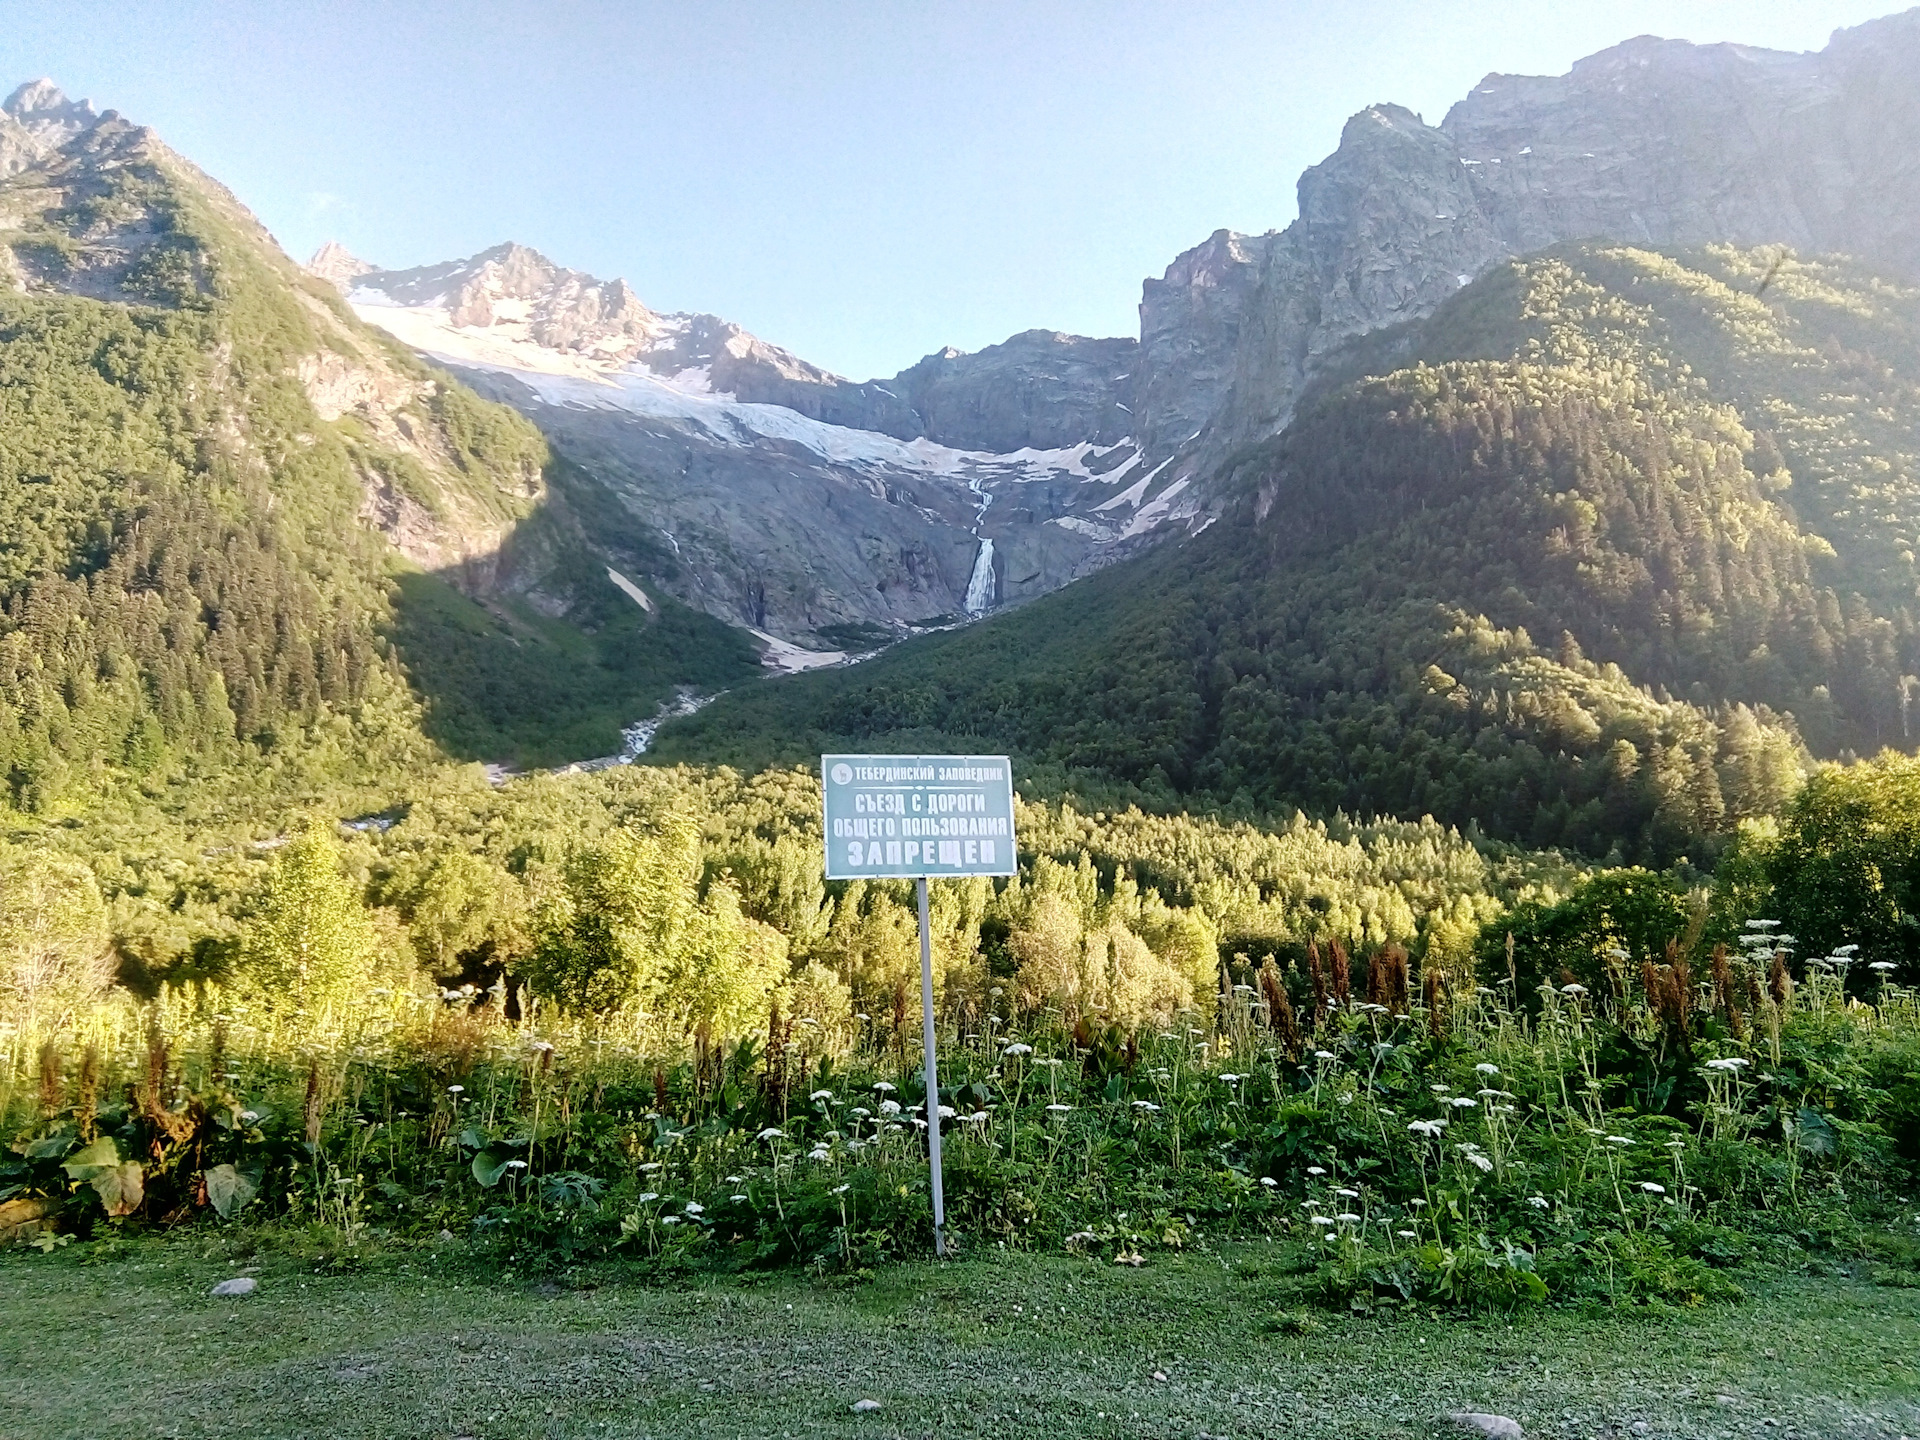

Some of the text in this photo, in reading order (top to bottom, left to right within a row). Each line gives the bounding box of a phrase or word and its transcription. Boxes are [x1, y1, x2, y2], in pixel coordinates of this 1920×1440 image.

[855, 765, 1003, 782] ТЕБЕРДИНСКИЙ ЗАПОВЕДНИК
[855, 793, 985, 815] СЪЕЗД С ДОРОГИ
[833, 817, 1007, 839] ОБЩЕГО ПОЛЬЗОВАНИЯ
[847, 840, 996, 868] ЗАПРЕЩЕН
